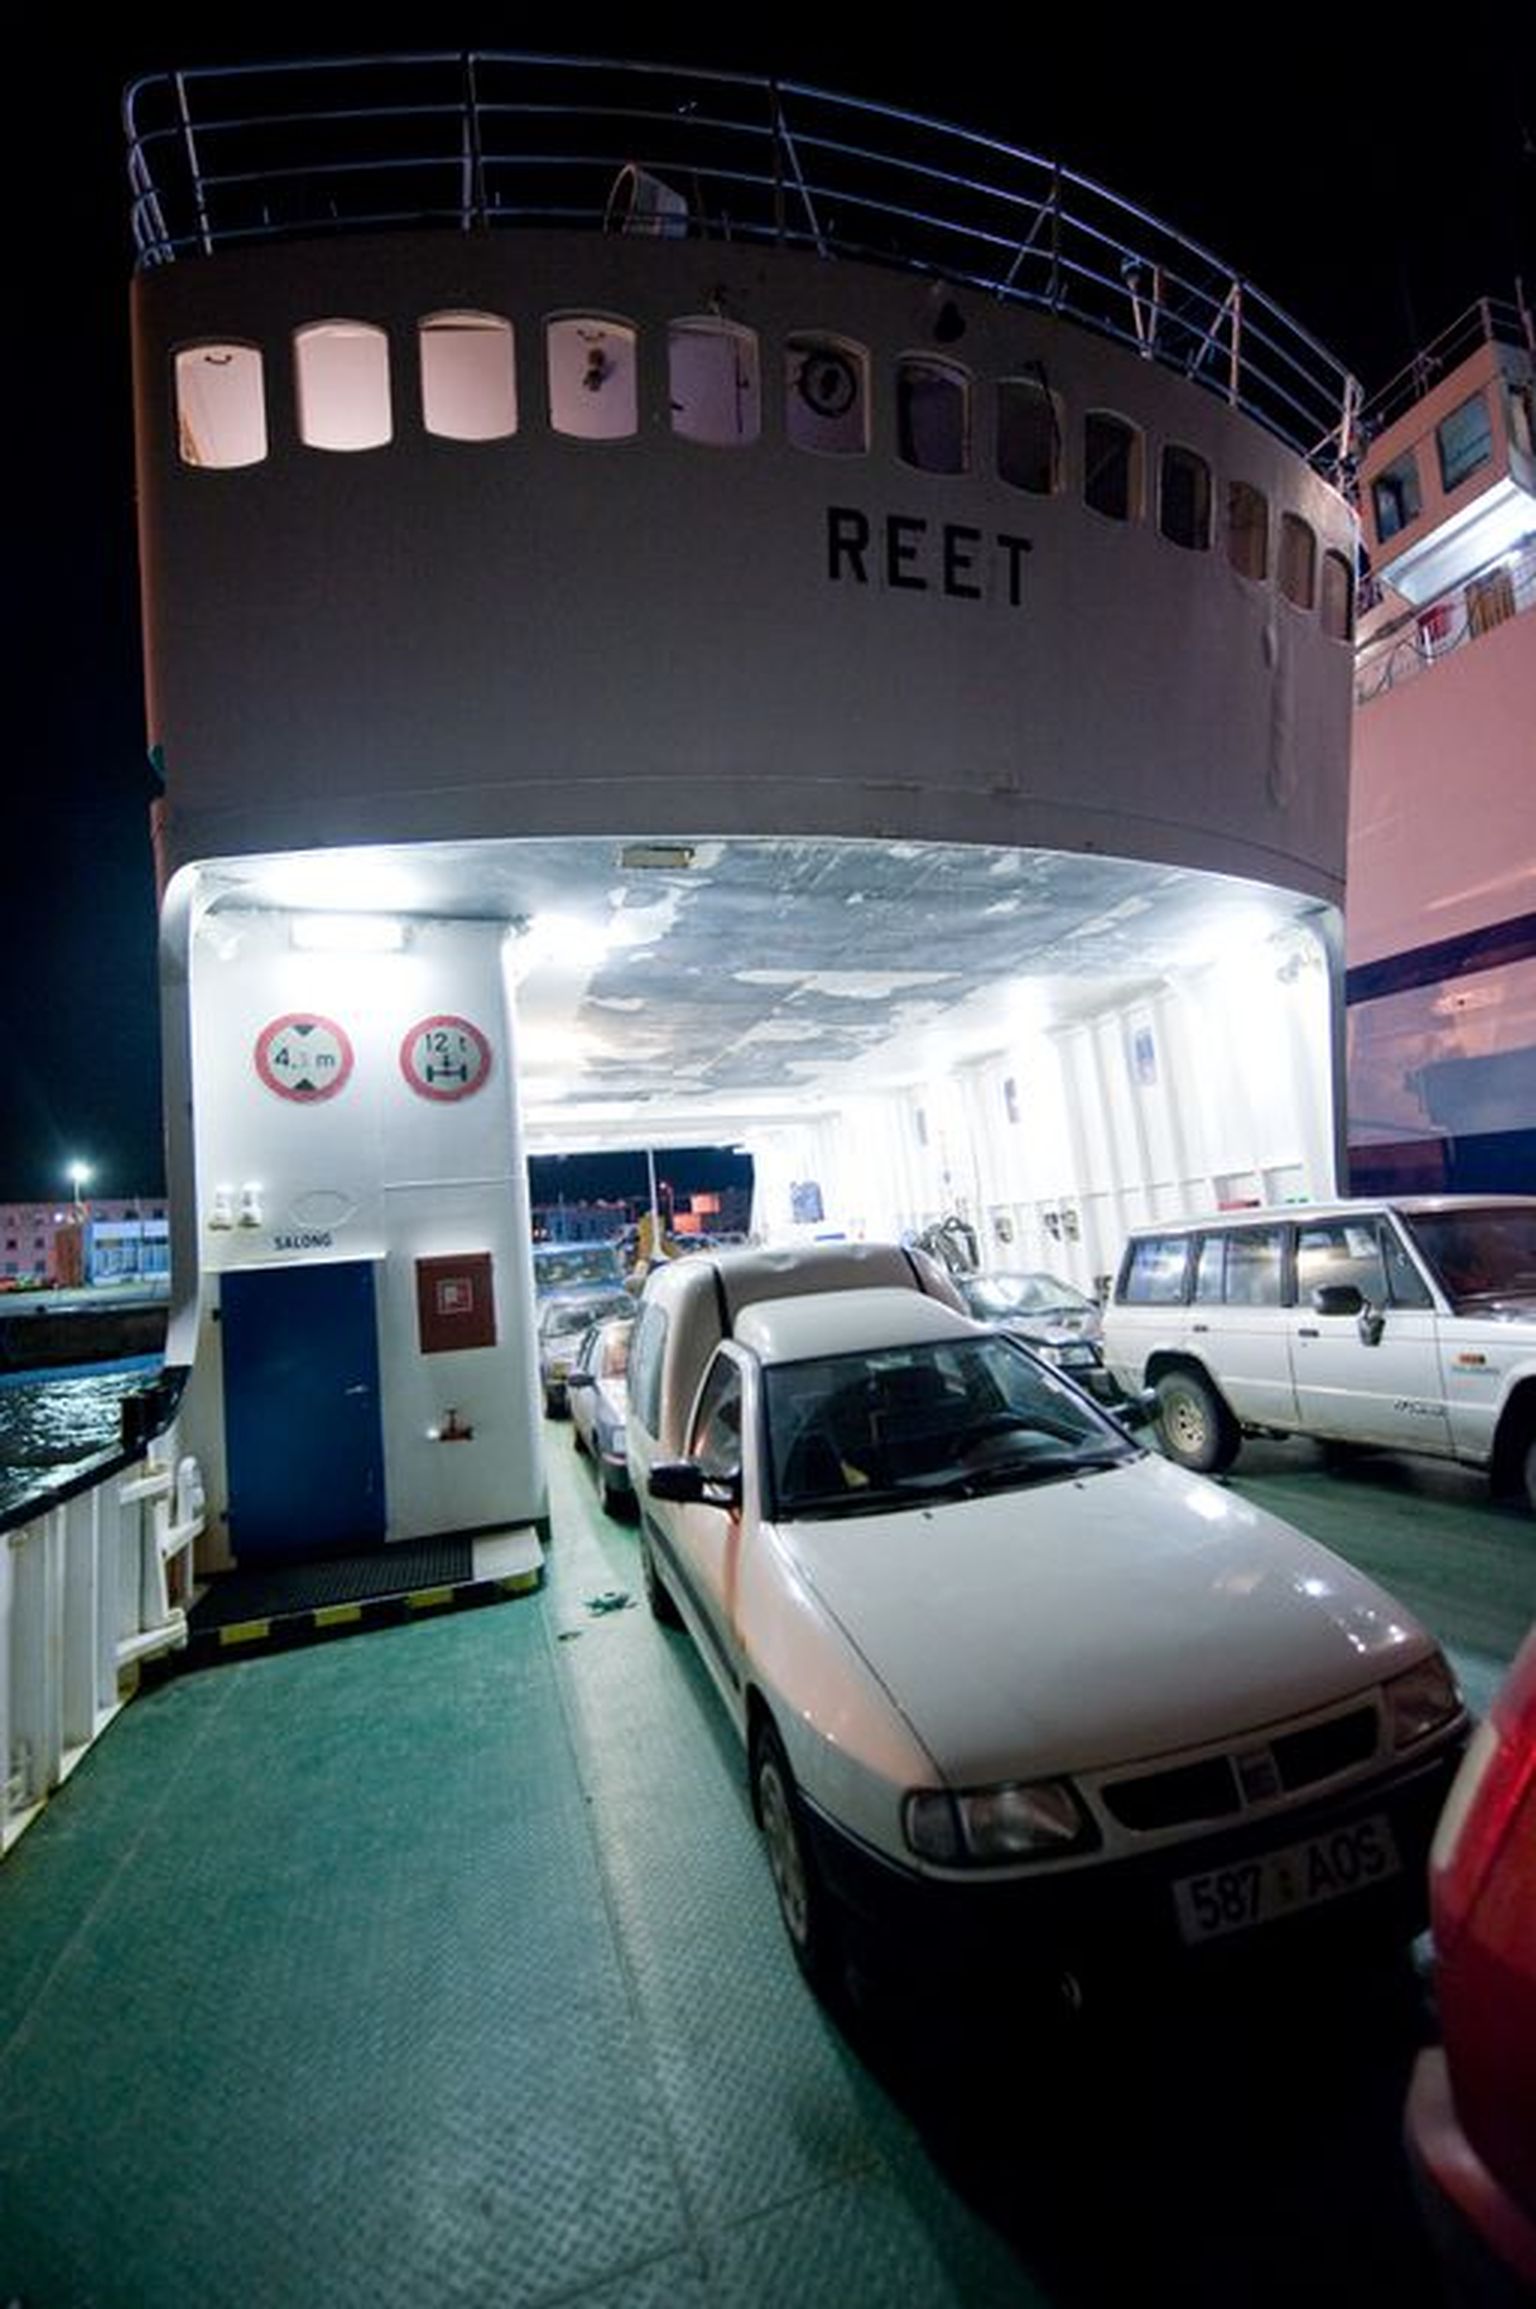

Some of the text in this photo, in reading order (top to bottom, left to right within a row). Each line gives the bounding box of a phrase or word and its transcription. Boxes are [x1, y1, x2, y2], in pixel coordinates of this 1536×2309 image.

[827, 506, 1034, 606] REET
[426, 1032, 448, 1053] 12
[315, 1053, 336, 1068] m
[274, 1232, 333, 1251] SALONG
[1193, 1824, 1386, 1930] 587 AOS
